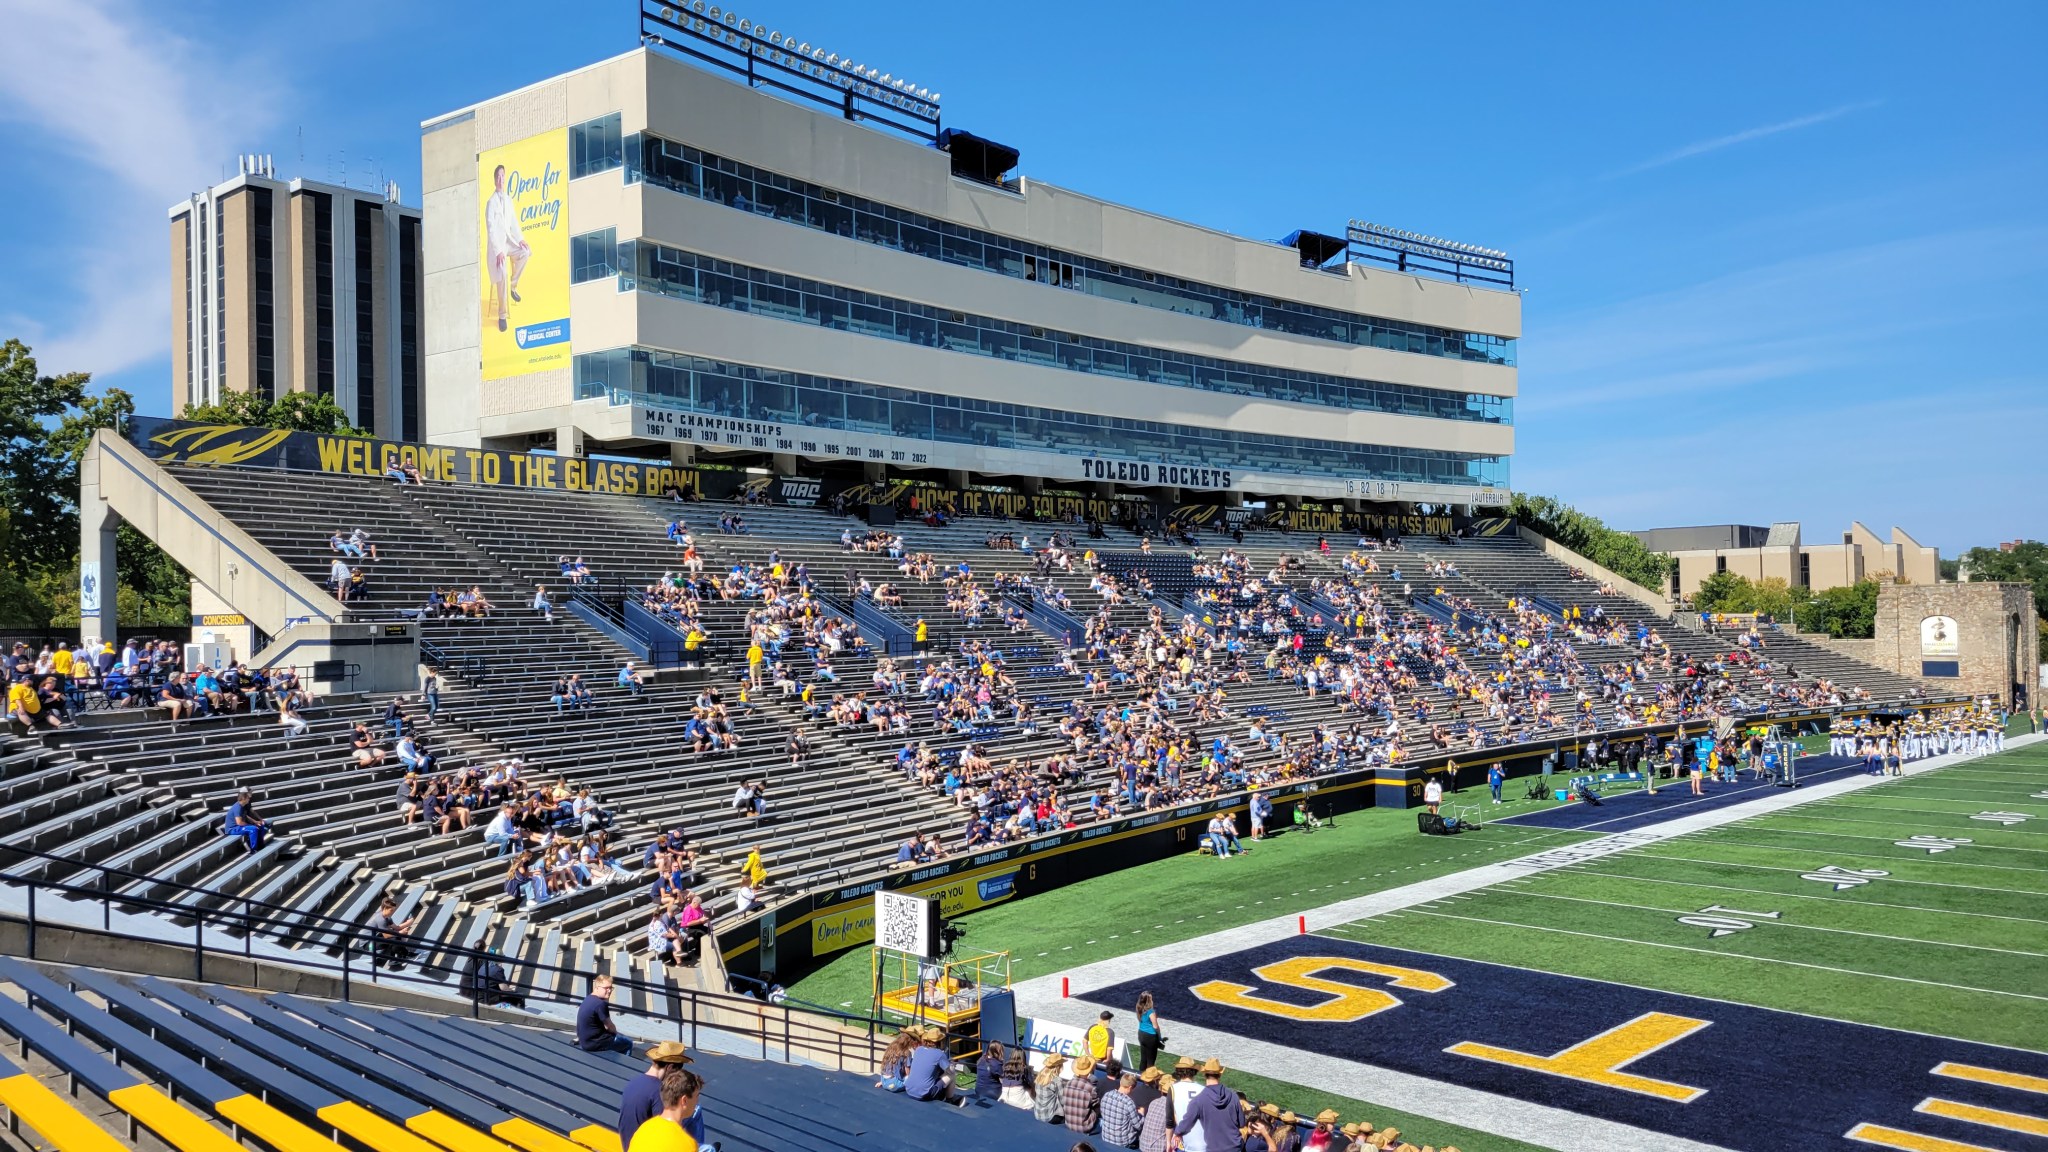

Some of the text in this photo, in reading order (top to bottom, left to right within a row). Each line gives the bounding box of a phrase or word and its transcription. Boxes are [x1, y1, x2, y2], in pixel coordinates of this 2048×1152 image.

[507, 162, 561, 201] Open for
[521, 200, 562, 230] caring
[646, 410, 782, 436] MAC CHAMPIONSHIPS
[647, 424, 664, 435] 1967
[674, 427, 692, 439] 1969
[701, 430, 718, 442] 1970
[727, 433, 742, 445] 1971
[751, 436, 767, 447] 1981
[776, 439, 792, 450] 1984
[824, 443, 839, 454] 1995
[891, 451, 905, 461] 2017
[912, 453, 927, 463] 2022
[317, 437, 705, 499] WELCOME TO THE GLASS BOWL
[1082, 458, 1231, 488] TOLEDO ROCKETS
[781, 482, 821, 498] MAC
[1345, 480, 1400, 495] 16 82 18 77
[964, 491, 982, 515] OF
[1032, 496, 1084, 519] TOLEDO
[1288, 510, 1343, 531] WELCOME
[1425, 516, 1456, 535] BOWL
[202, 614, 245, 625] CONCESSION
[1412, 785, 1421, 797] 30
[1177, 827, 1186, 842] 10
[974, 850, 1008, 865] TOLEDO ROCKETS
[912, 864, 950, 881] TOLEDO ROCKETS
[1029, 864, 1036, 880] G
[841, 881, 884, 899] TOLEDO ROCKETS
[948, 886, 964, 898] YOU
[817, 917, 875, 942] Open for carin
[1030, 1031, 1086, 1057] LAKES
